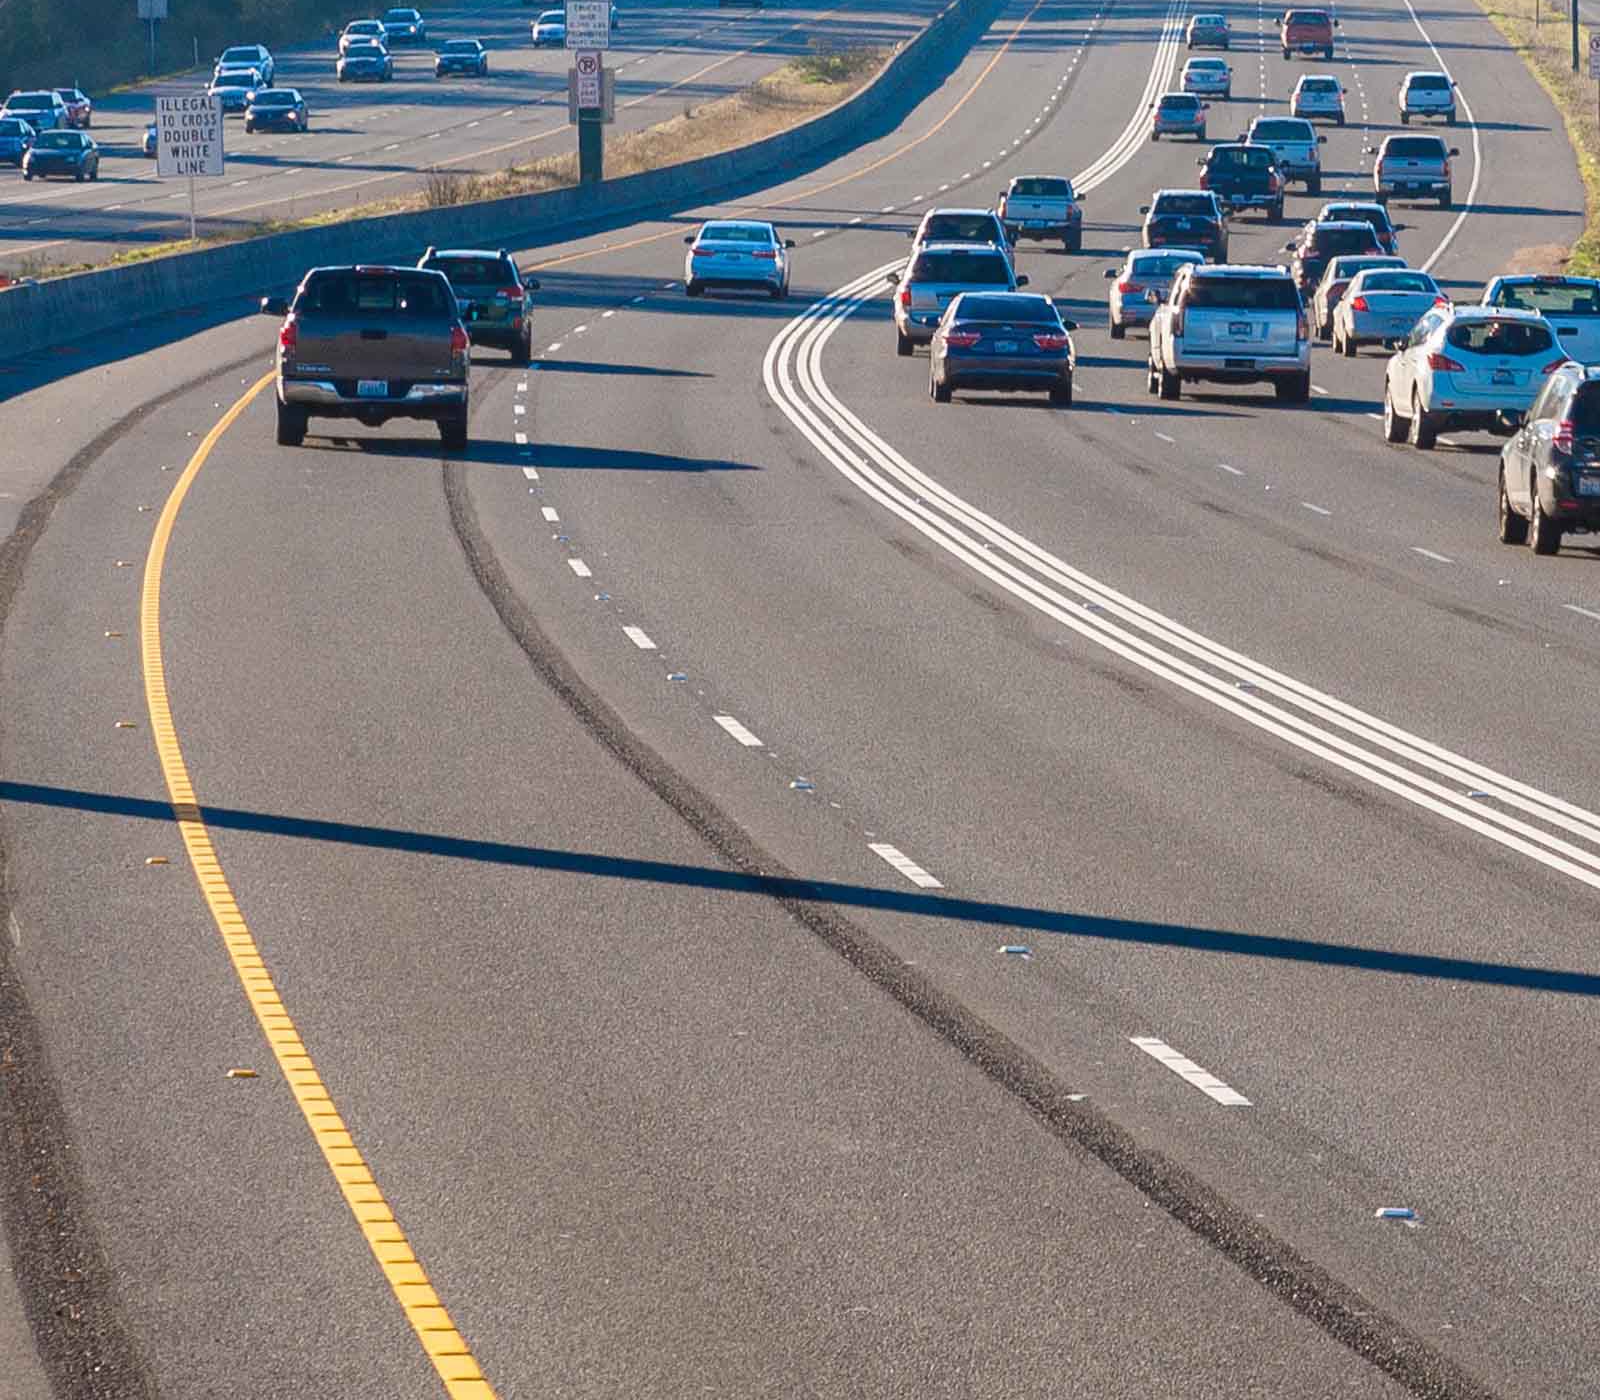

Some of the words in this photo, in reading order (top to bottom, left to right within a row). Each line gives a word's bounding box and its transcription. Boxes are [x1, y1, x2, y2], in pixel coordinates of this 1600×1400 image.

[161, 98, 217, 111] ILLEGAL
[162, 114, 175, 127] TO
[182, 113, 217, 127] CROSS
[164, 129, 216, 143] DOUBLE
[171, 144, 211, 158] WHITE
[177, 160, 207, 175] LINE
